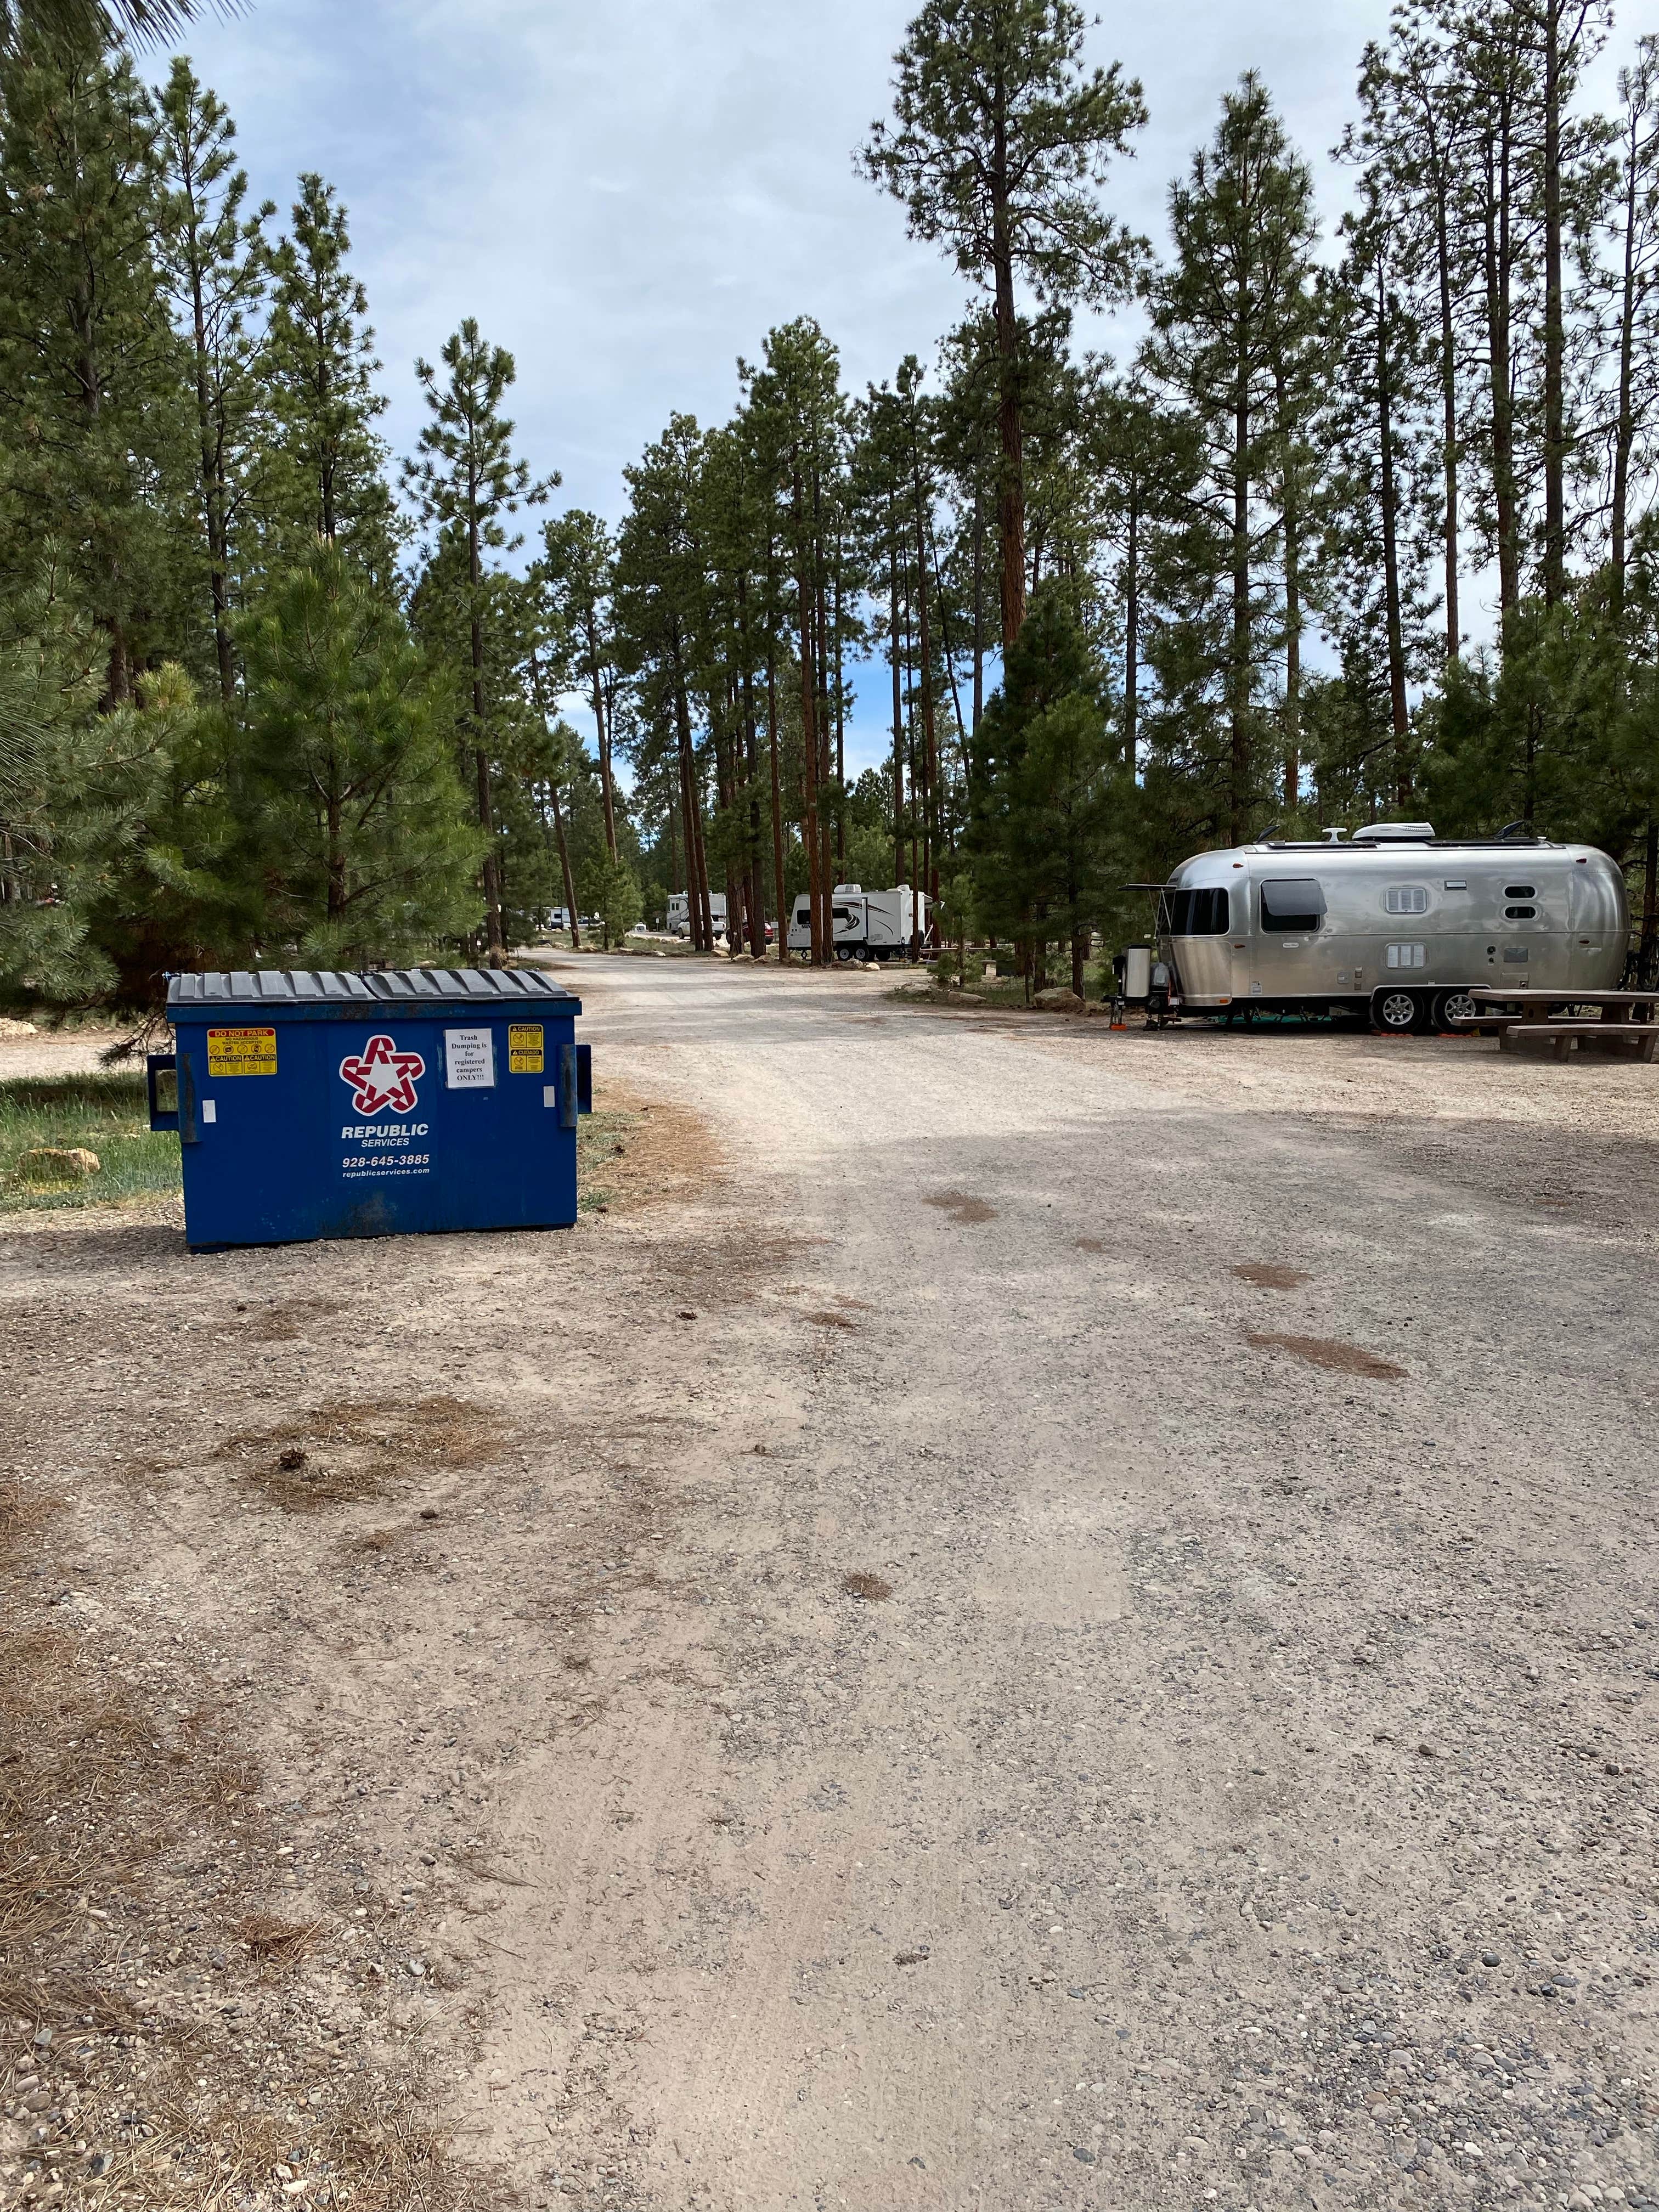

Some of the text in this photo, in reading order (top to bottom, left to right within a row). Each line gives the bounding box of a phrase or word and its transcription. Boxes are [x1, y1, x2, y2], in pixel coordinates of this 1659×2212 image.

[454, 1058, 485, 1066] registered
[341, 1124, 429, 1139] REPUBLIC
[361, 1138, 410, 1148] SERVICES
[342, 1154, 430, 1168] 928-645-3885
[342, 1168, 430, 1178] republicservices.com
